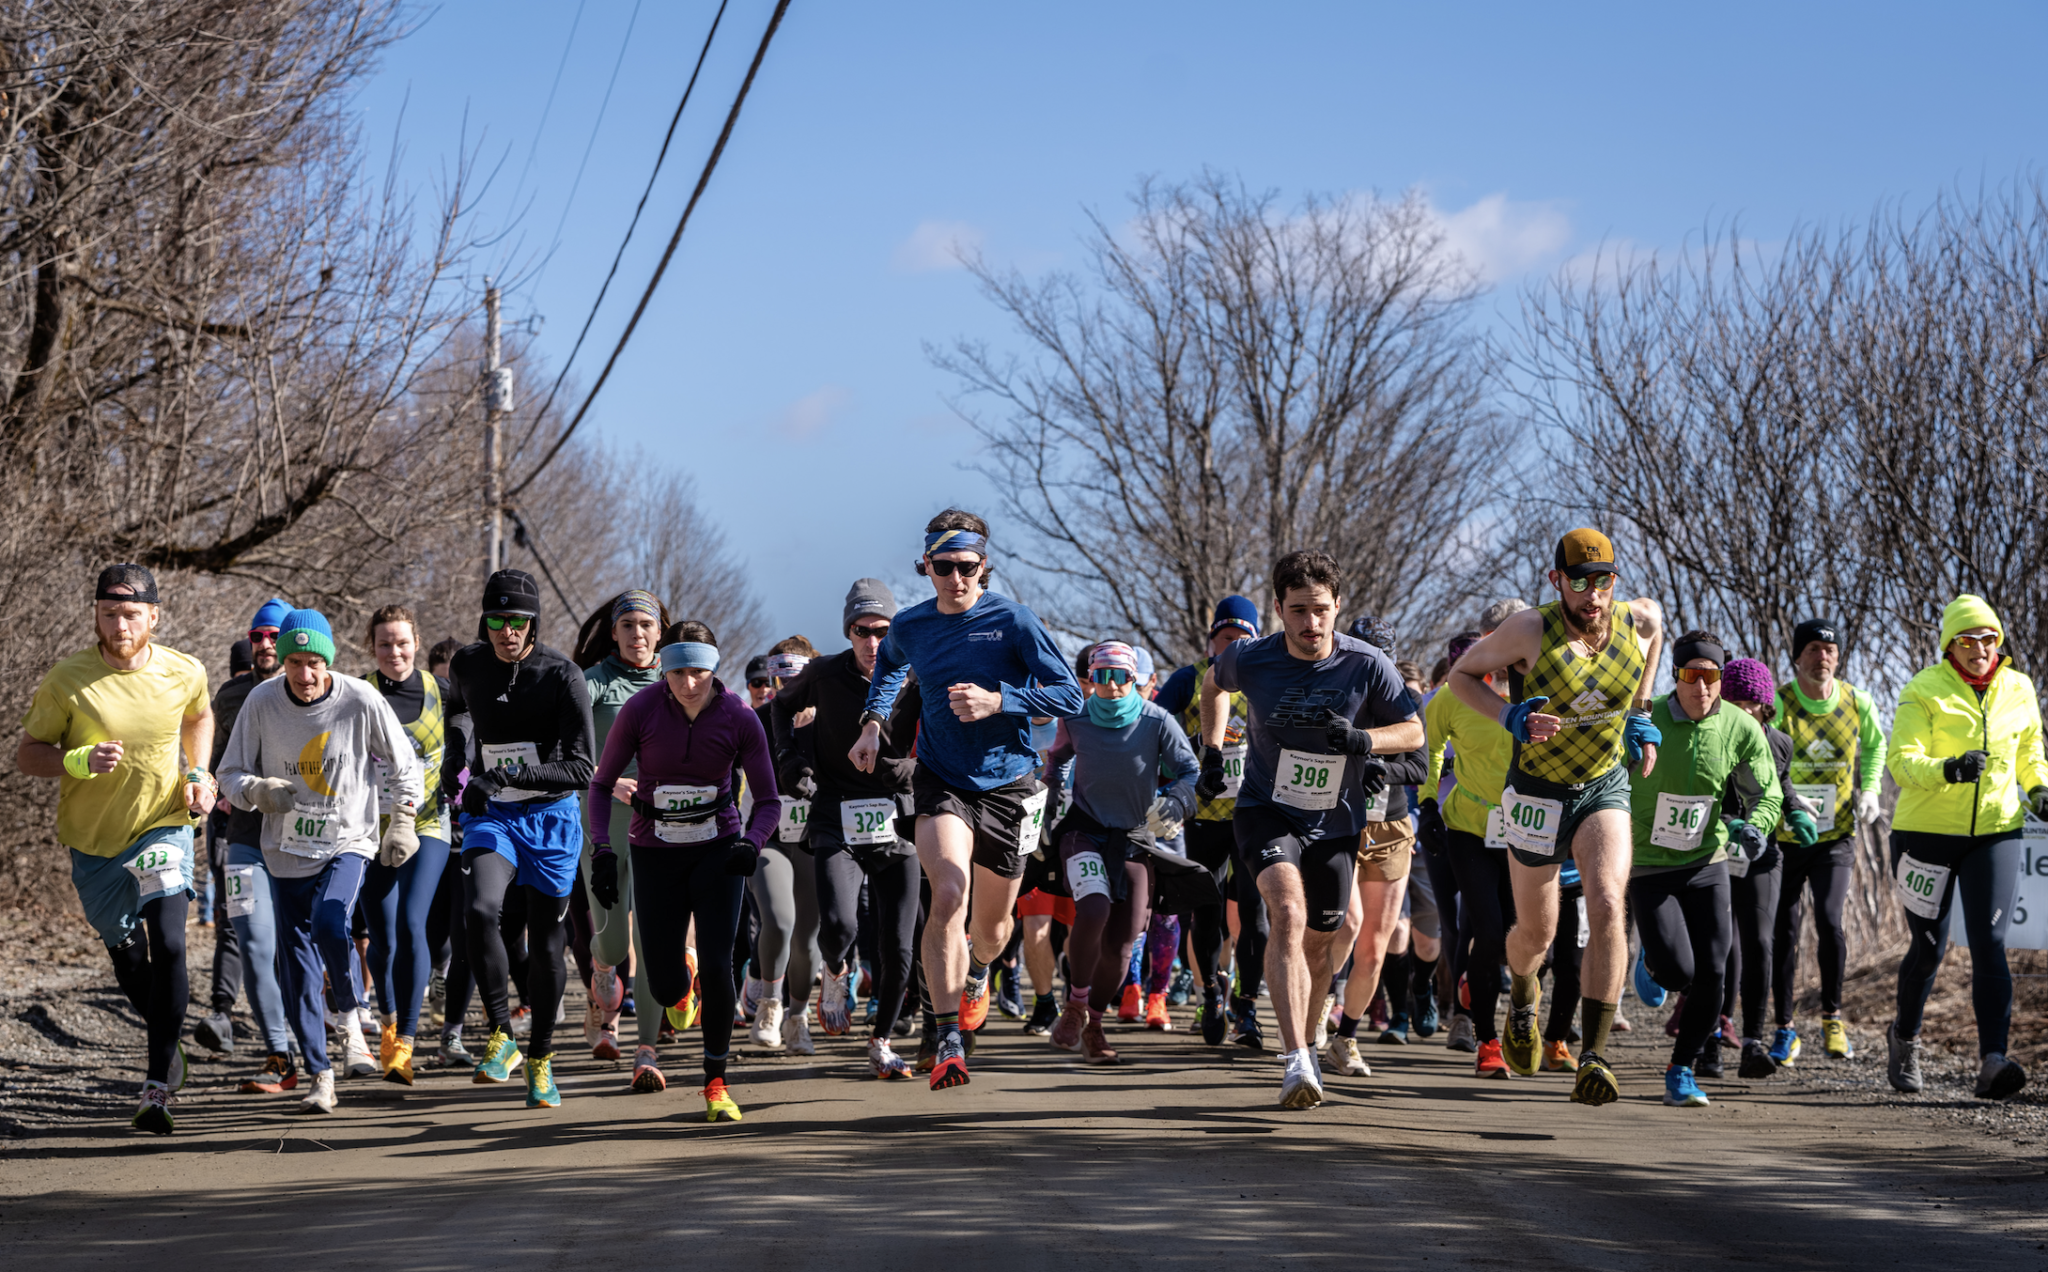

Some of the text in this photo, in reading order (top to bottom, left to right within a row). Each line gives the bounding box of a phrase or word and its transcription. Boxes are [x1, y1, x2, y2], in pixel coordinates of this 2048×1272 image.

[1579, 710, 1622, 722] MOUNTAIN
[284, 760, 321, 776] PEACHTREE
[1290, 753, 1313, 763] Kaynor's
[1290, 763, 1329, 789] 398
[790, 805, 811, 824] 41
[854, 811, 885, 833] 329
[1511, 801, 1546, 830] 400
[1667, 806, 1699, 829] 346
[295, 816, 326, 838] 407
[135, 850, 168, 871] 433
[1078, 860, 1107, 881] 394
[227, 875, 241, 896] 03
[1905, 870, 1936, 897] 406
